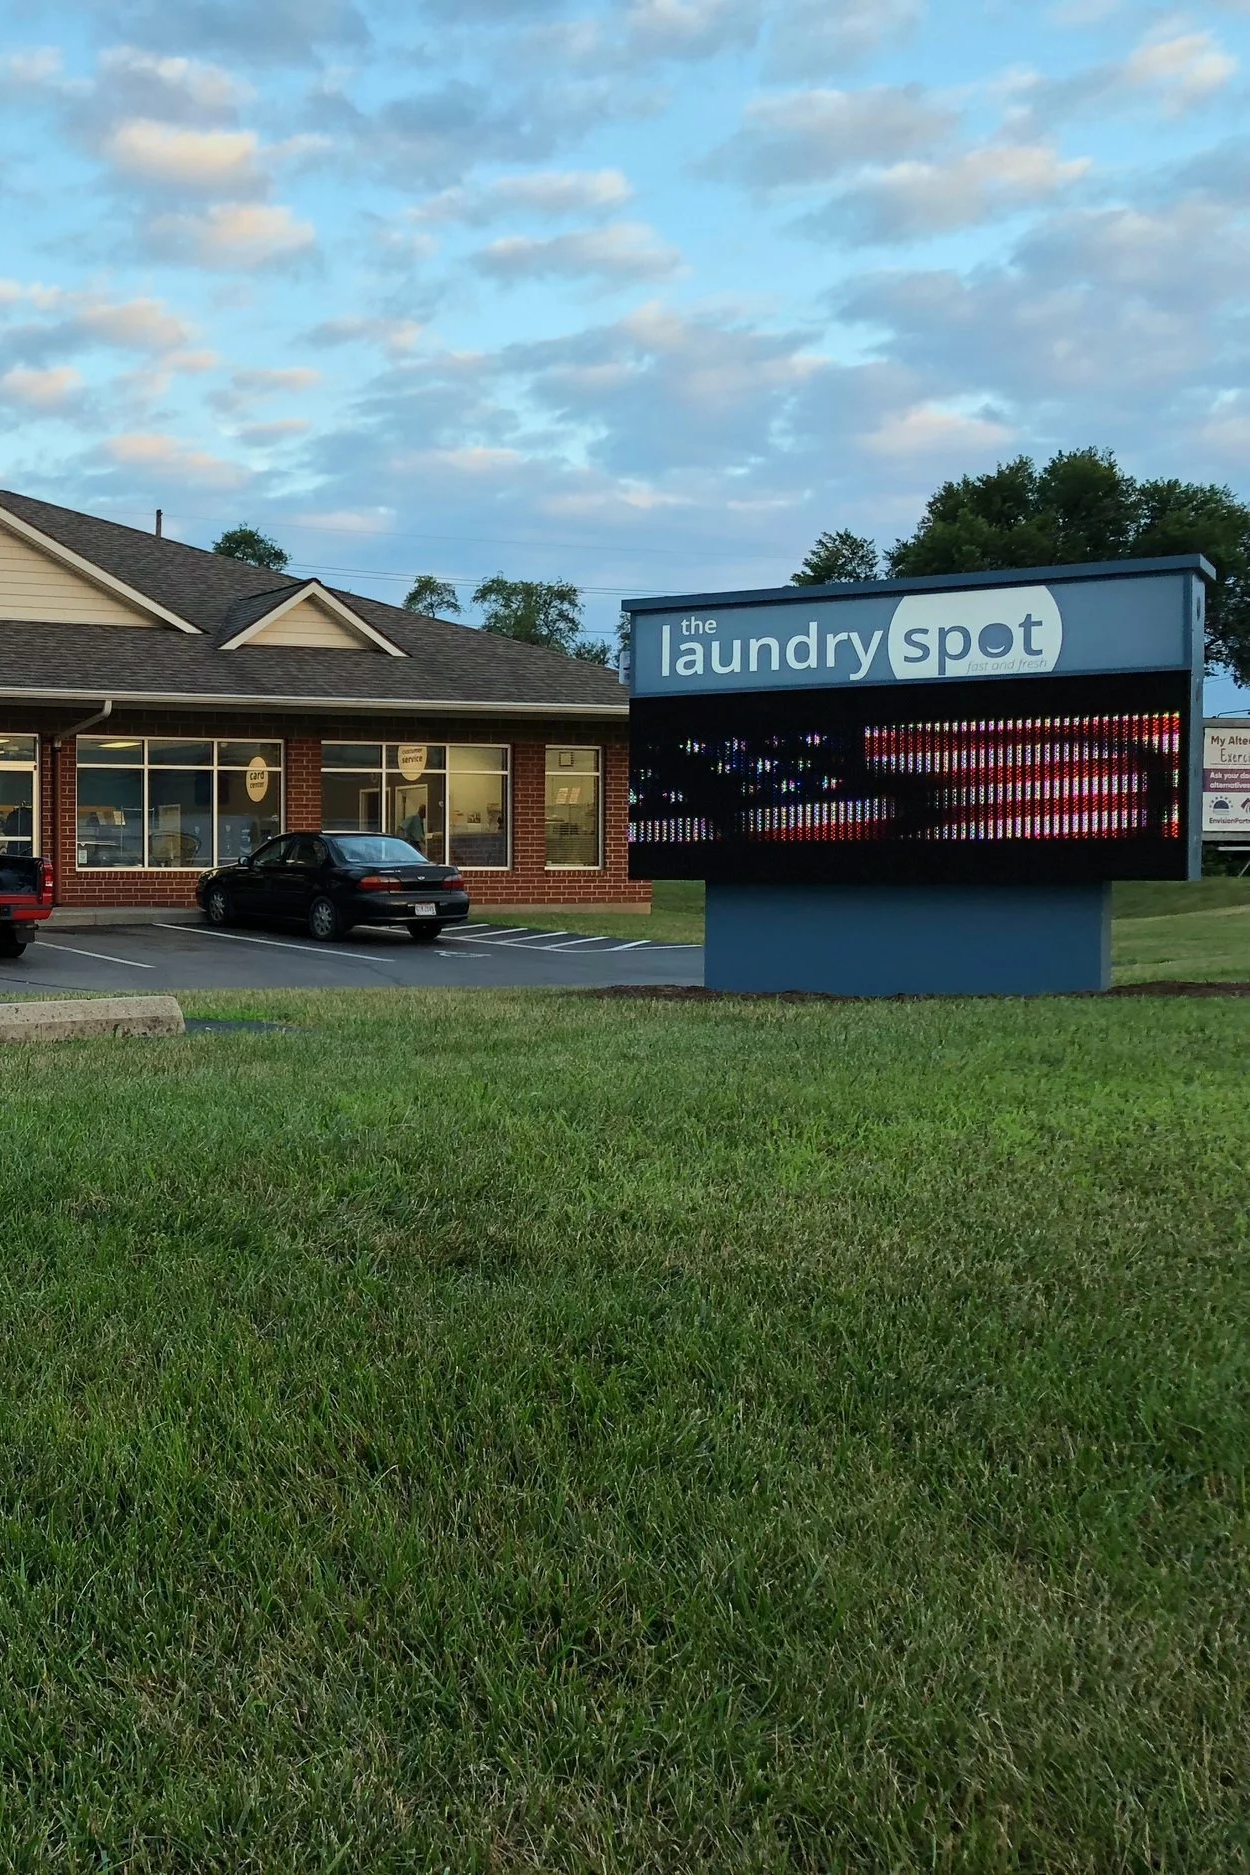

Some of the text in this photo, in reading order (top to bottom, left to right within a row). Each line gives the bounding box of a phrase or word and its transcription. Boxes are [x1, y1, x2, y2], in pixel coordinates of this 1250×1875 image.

[680, 616, 717, 635] the
[661, 613, 1043, 681] laundry spot
[966, 658, 1047, 674] fast and fresh
[1210, 735, 1226, 747] My
[402, 755, 423, 764] service
[250, 770, 265, 780] card
[1223, 773, 1240, 781] your
